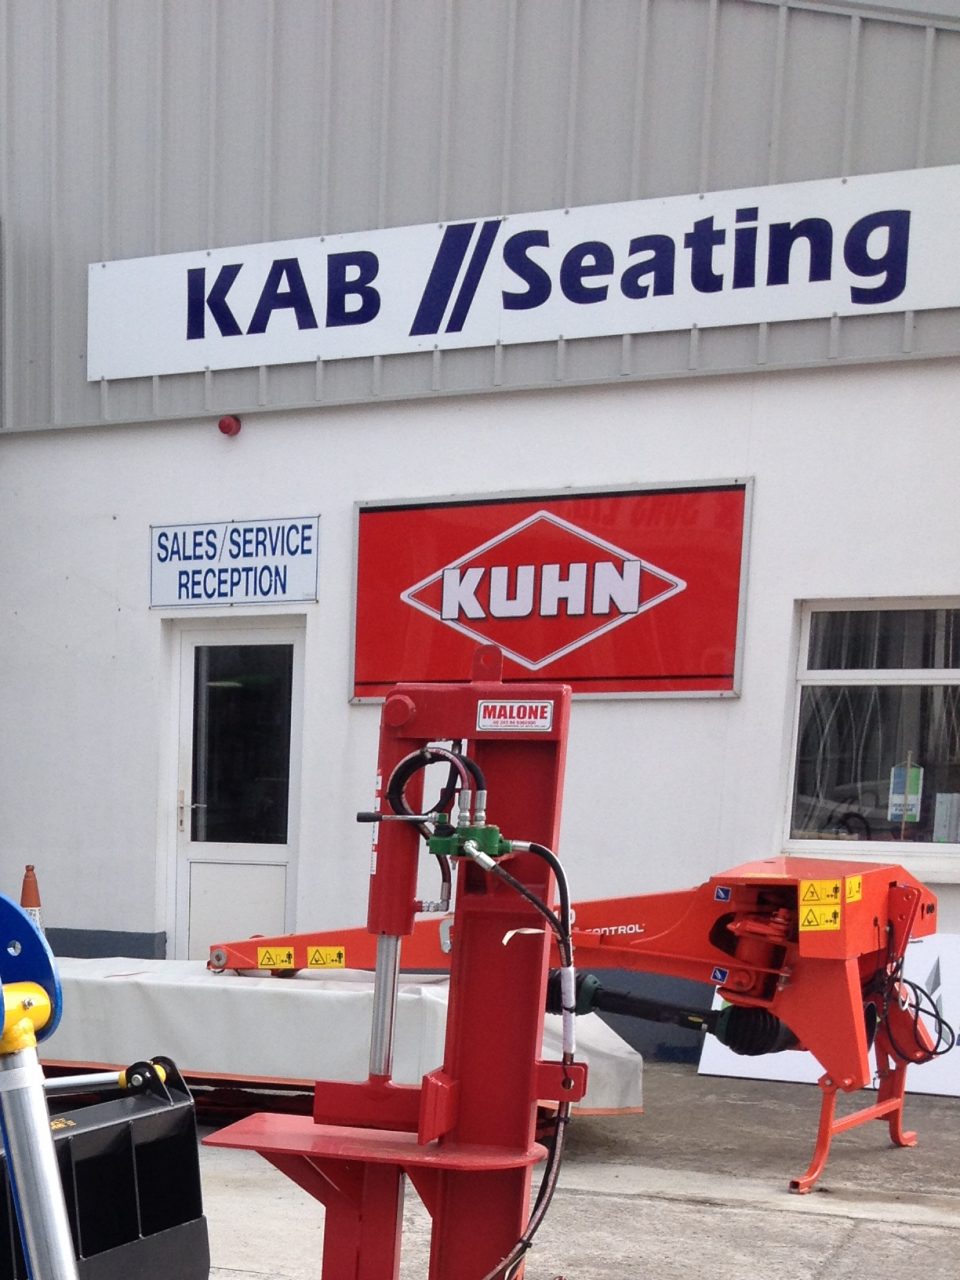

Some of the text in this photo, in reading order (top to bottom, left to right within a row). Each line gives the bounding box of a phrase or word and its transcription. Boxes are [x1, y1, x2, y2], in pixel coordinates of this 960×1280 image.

[186, 206, 911, 340] KAB Seating
[157, 524, 313, 563] SALES/SERVICE
[178, 565, 287, 600] RECEPTION
[441, 559, 641, 620] KUHN
[482, 704, 548, 720] MALONE
